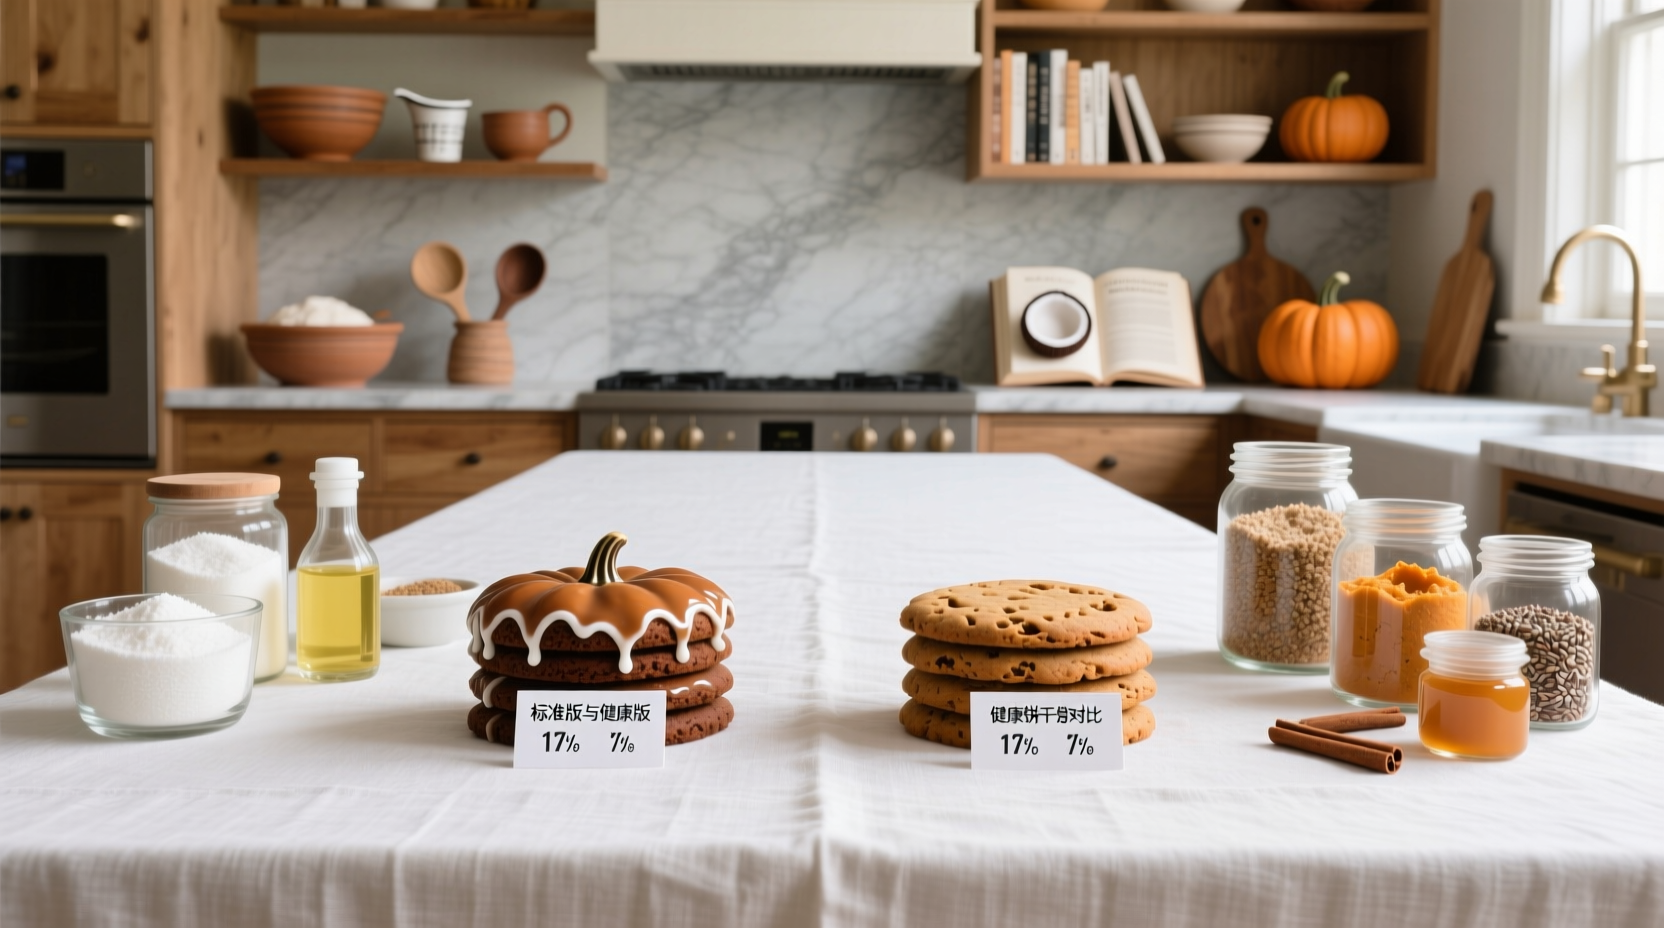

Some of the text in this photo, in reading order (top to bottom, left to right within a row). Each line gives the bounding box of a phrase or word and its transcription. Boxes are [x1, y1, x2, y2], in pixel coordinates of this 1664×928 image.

[530, 702, 651, 722] 标准版与健康版
[542, 731, 580, 753] 17%
[1000, 733, 1039, 755] 17%
